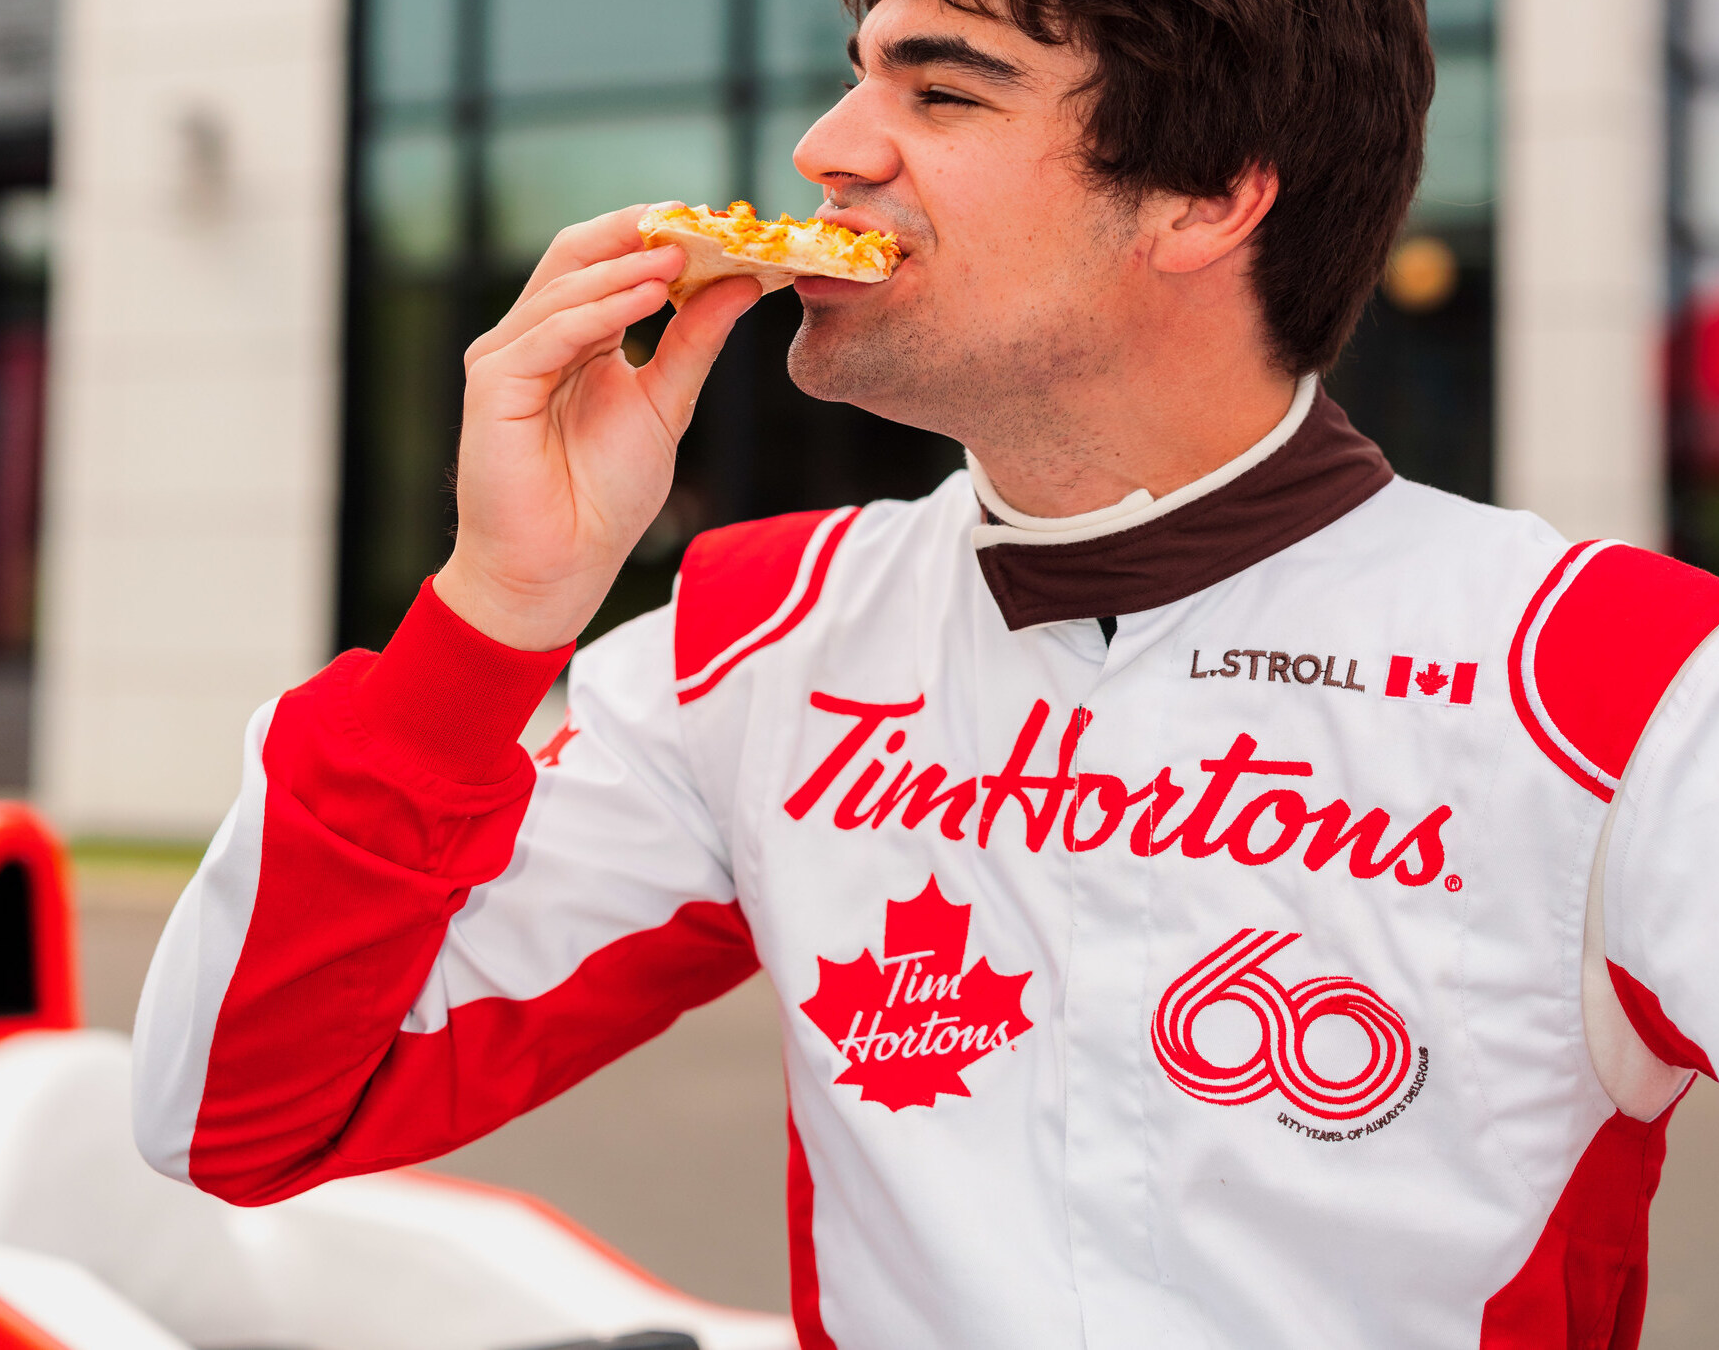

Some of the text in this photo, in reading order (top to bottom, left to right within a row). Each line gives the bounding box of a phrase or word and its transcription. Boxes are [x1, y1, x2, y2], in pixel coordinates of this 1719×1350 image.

[1190, 649, 1365, 693] L.STROLL
[882, 950, 964, 1008] Tim
[1150, 928, 1412, 1121] 60
